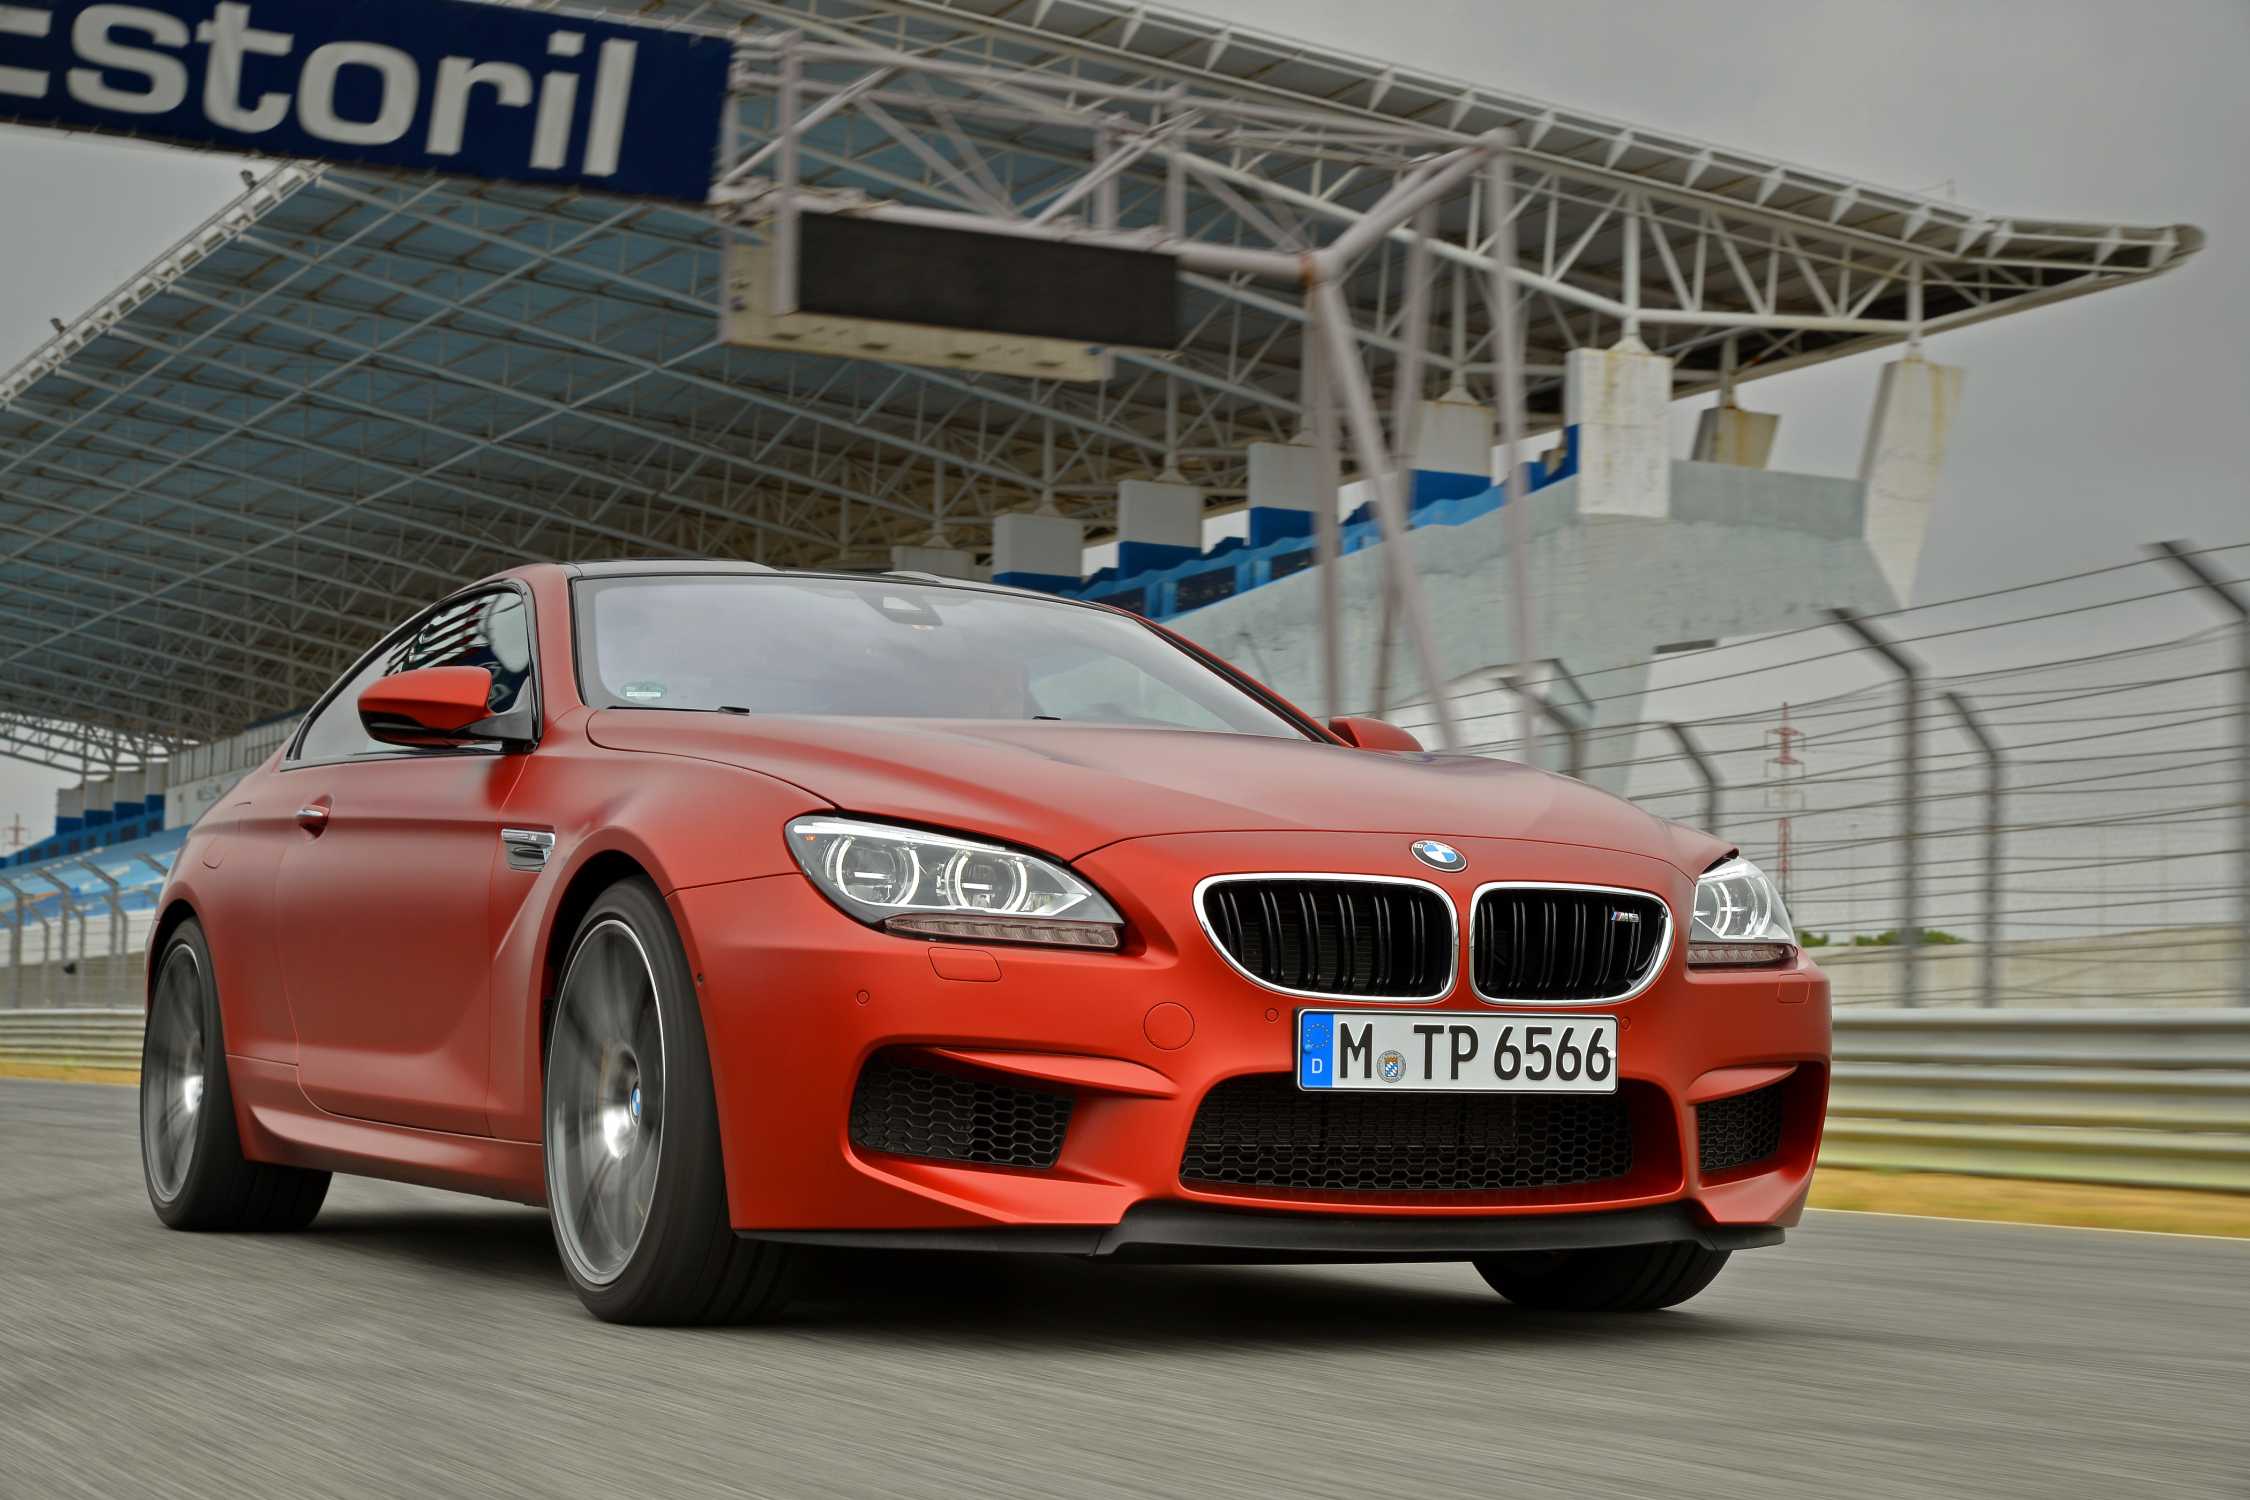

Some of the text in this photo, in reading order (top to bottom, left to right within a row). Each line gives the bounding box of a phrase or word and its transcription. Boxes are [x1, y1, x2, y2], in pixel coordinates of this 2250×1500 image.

[1312, 1058, 1323, 1074] D
[1340, 1023, 1611, 1082] M TP 6566
